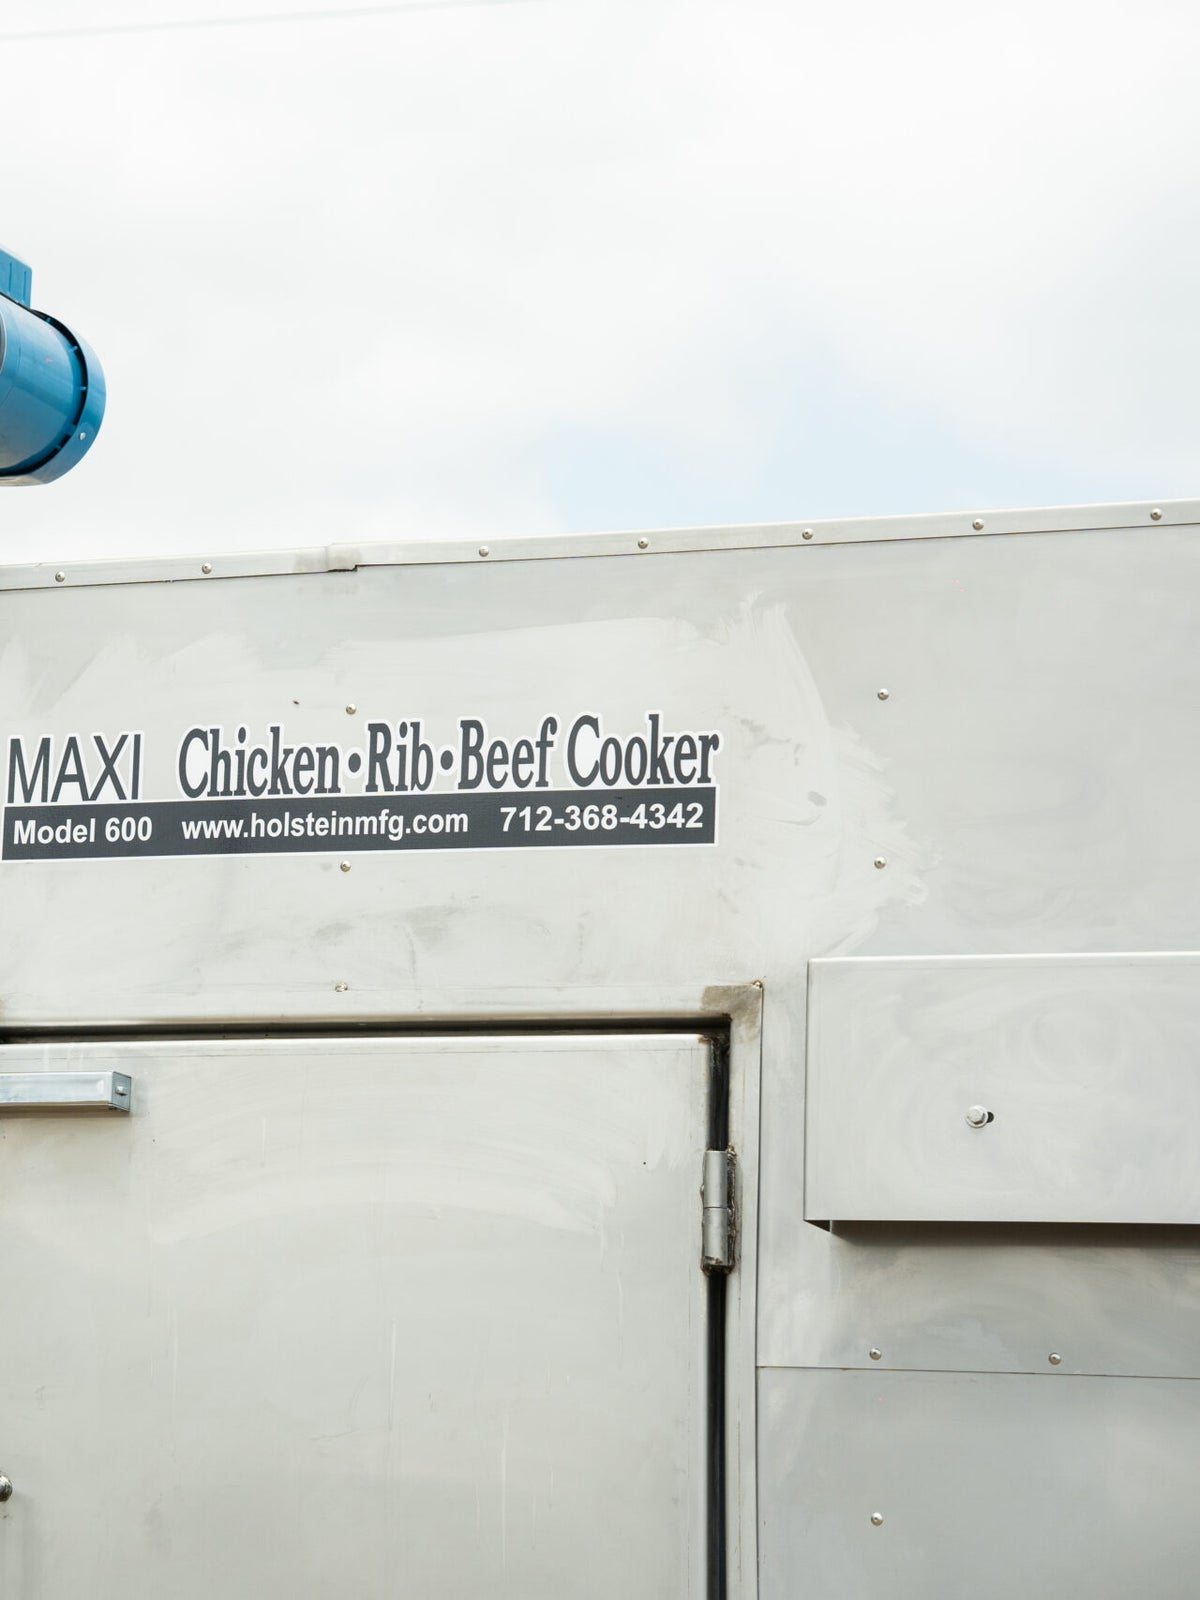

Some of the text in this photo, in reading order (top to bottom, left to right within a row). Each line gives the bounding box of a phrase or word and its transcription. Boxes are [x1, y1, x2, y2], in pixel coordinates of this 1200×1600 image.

[7, 733, 142, 804] MAXI
[567, 713, 720, 788] Cooker
[13, 802, 704, 845] Model 600 www.holsteinmfg.com 712-368-4342
